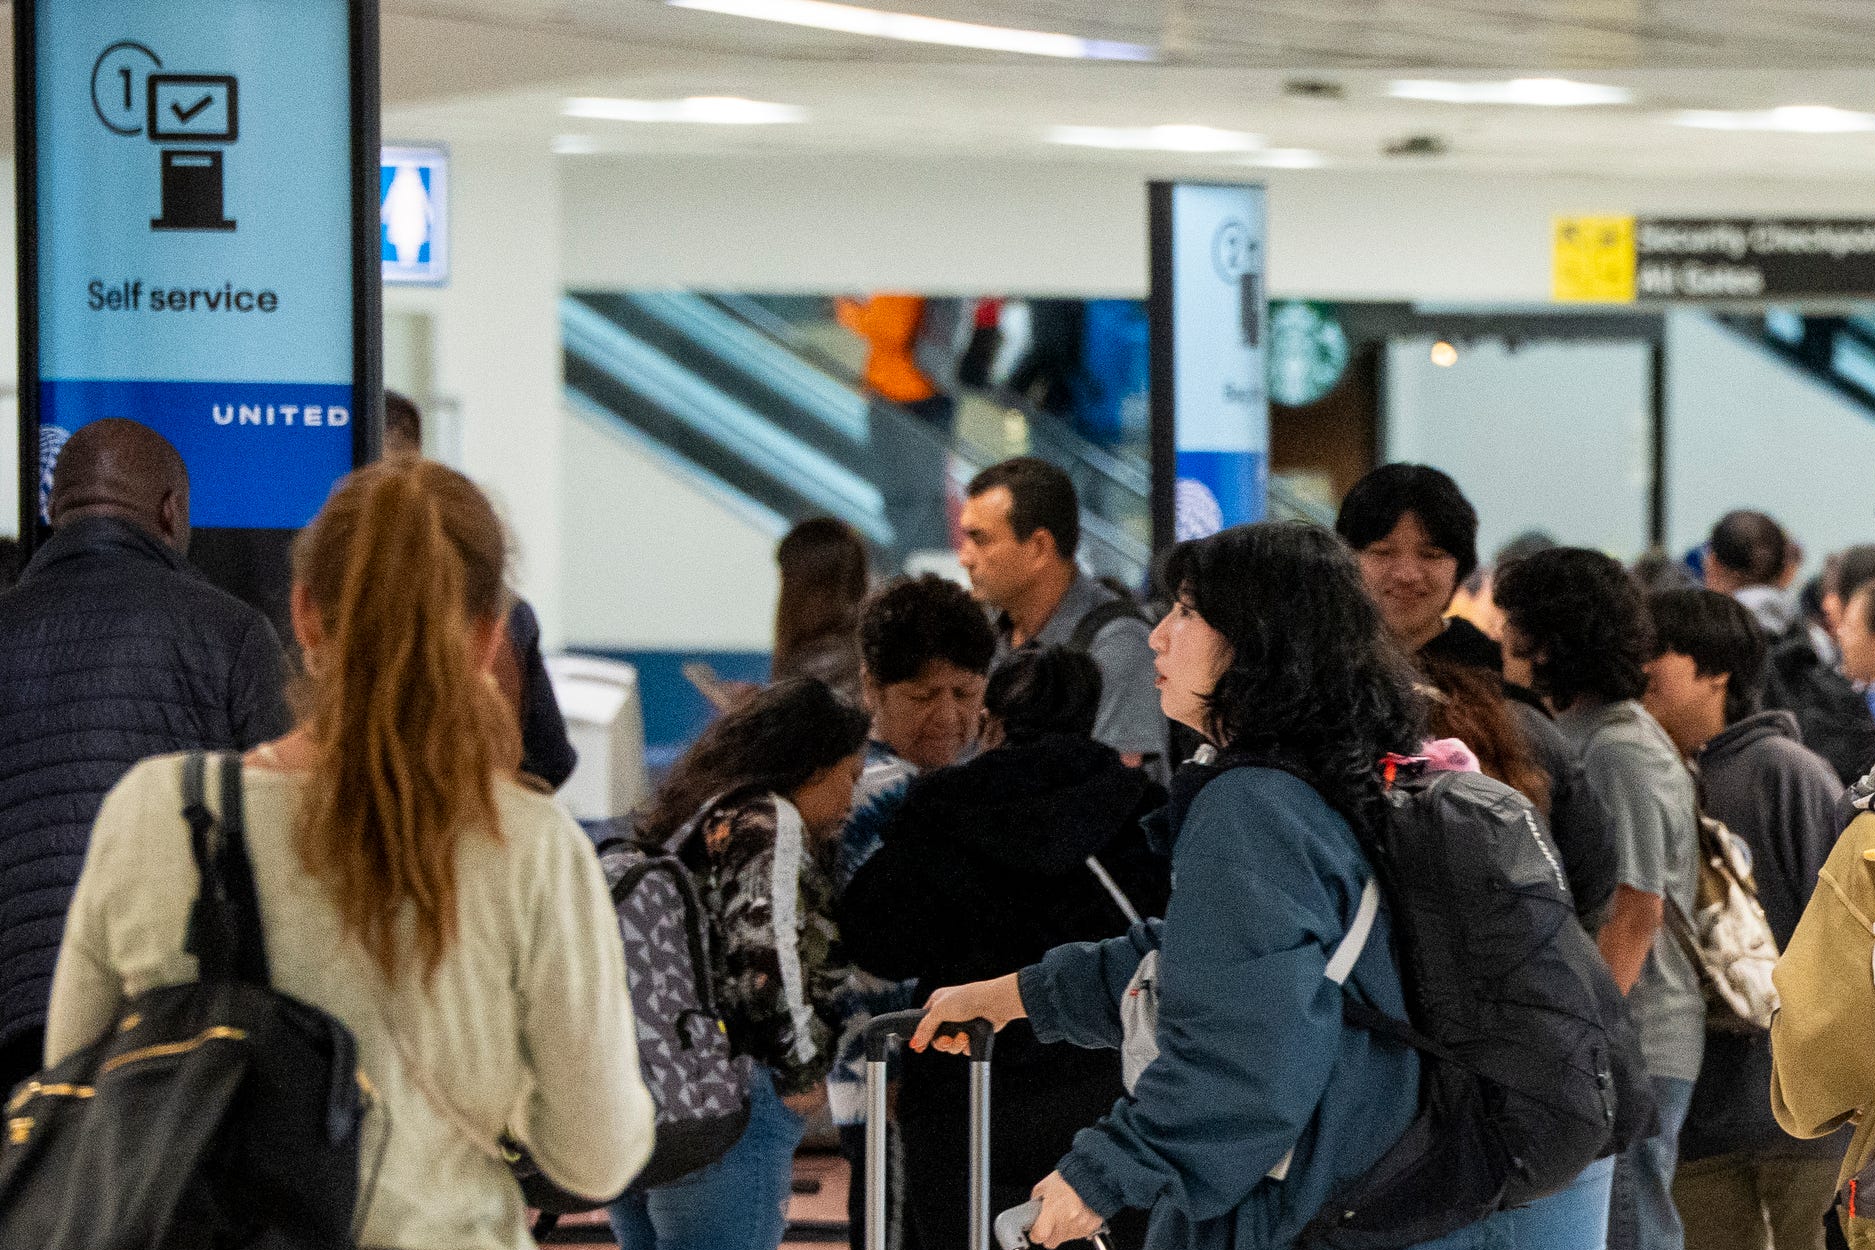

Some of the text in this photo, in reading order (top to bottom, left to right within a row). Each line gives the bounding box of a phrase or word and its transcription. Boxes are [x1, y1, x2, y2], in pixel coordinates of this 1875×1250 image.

[87, 279, 278, 313] Self service
[212, 403, 349, 427] UNITED
